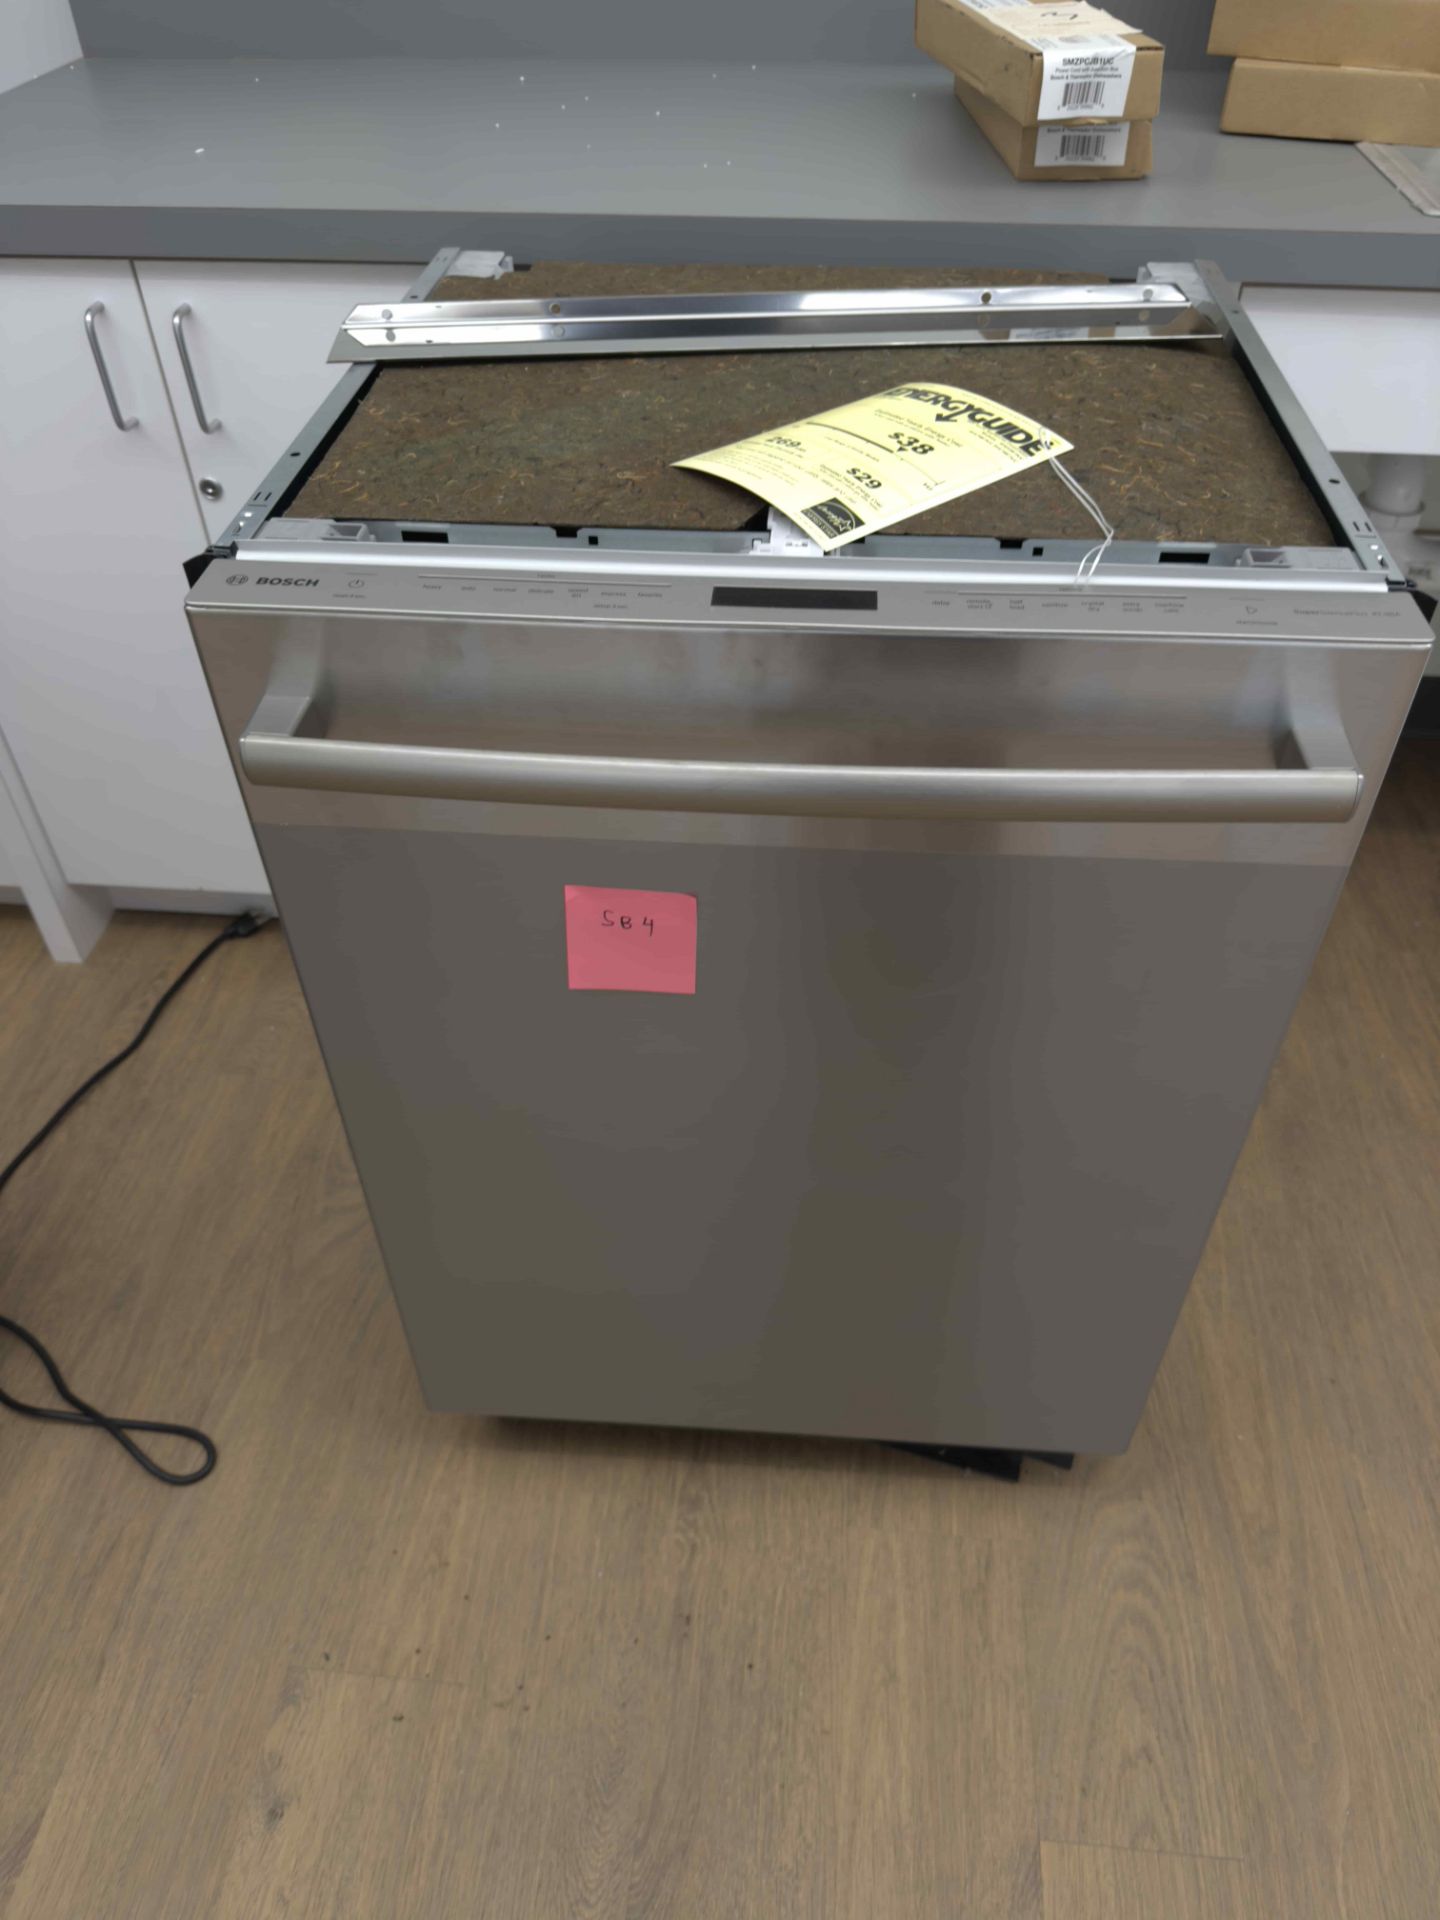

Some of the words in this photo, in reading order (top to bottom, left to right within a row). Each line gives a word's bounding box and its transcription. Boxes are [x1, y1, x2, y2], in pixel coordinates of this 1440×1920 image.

[882, 386, 1047, 458] ENERGYGUIDE
[887, 431, 935, 455] $38
[846, 467, 883, 490] $29
[255, 576, 320, 588] BOSCH
